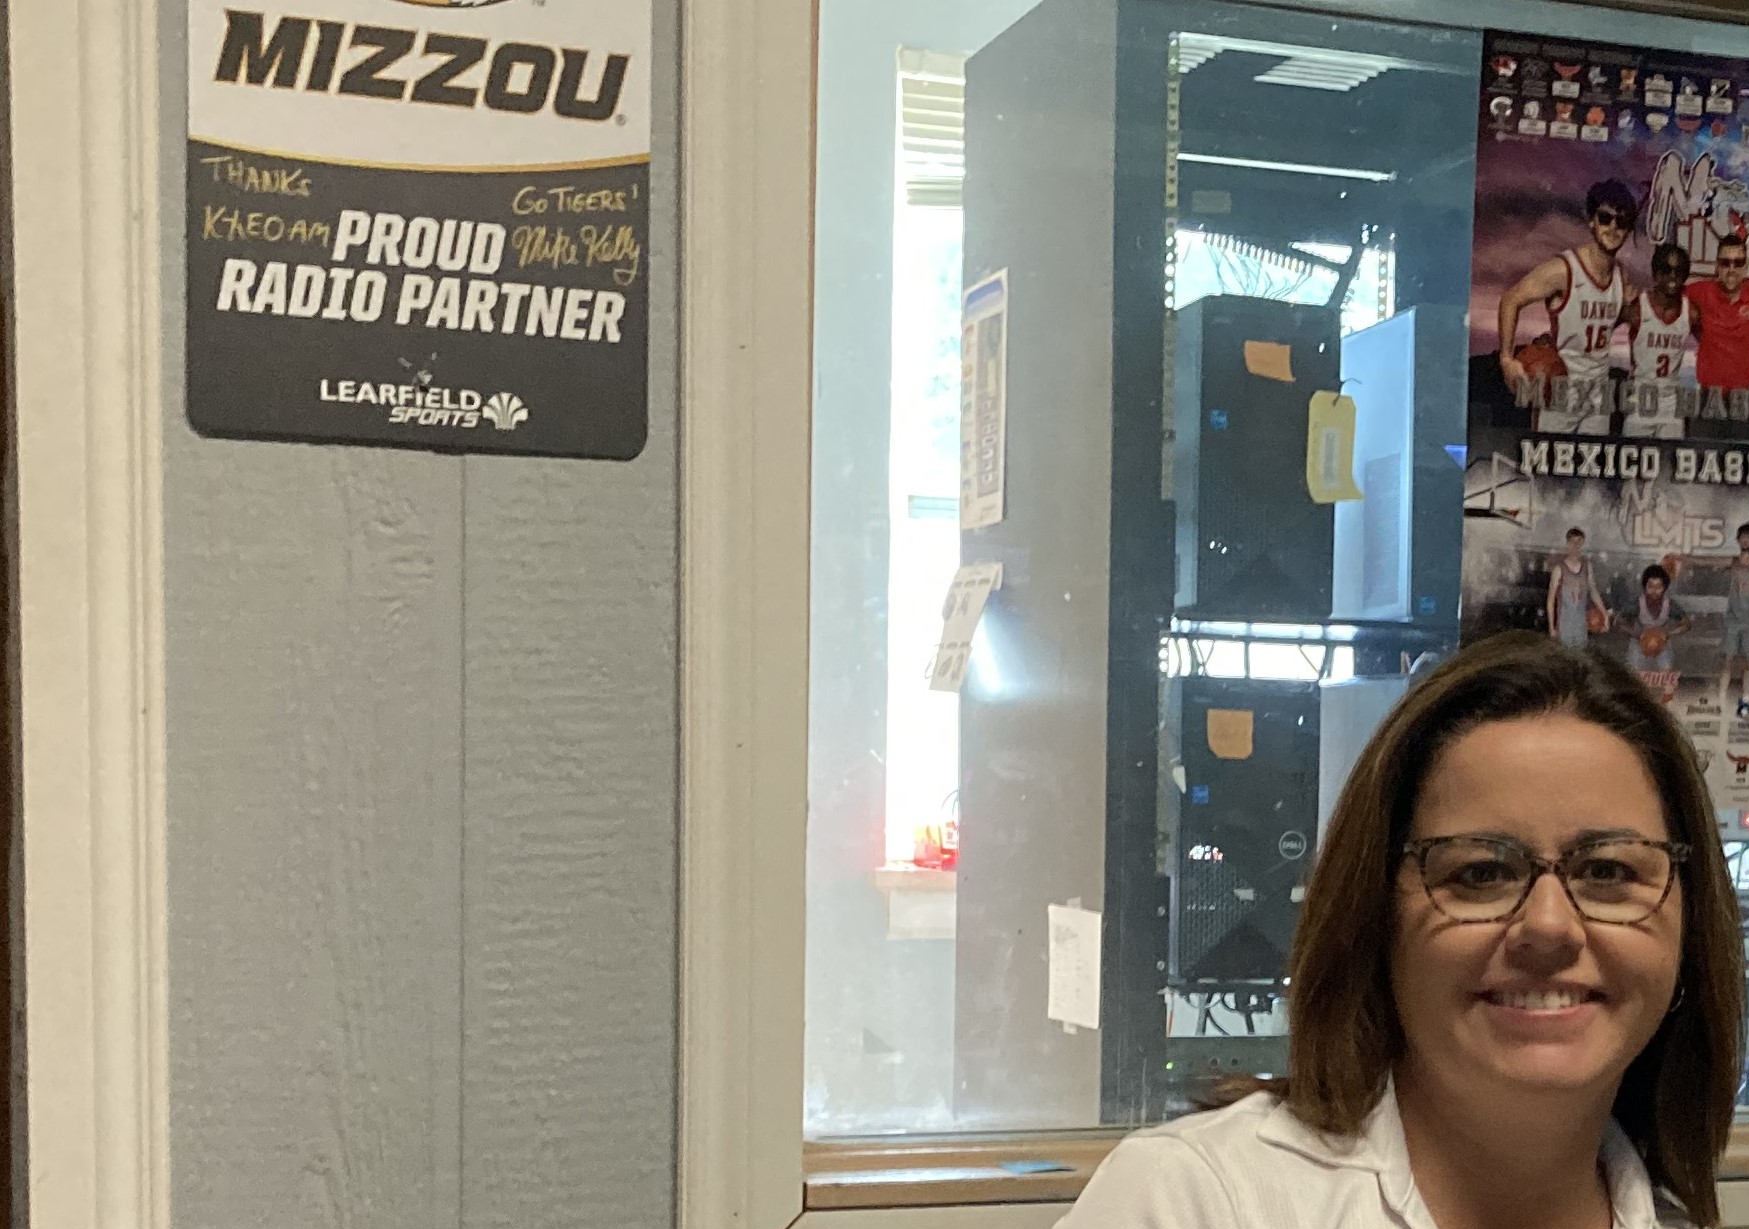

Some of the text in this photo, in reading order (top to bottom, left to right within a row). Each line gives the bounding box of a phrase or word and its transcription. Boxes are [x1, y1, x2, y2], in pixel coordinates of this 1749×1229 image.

[212, 8, 630, 122] MIZZOU
[200, 155, 312, 197] THANKS
[330, 209, 507, 275] PROUD
[216, 258, 627, 344] RADIO PARTNER
[319, 378, 482, 411] LEARFIELD
[388, 406, 481, 429] SPORTS
[1518, 438, 1662, 481] MEXICO
